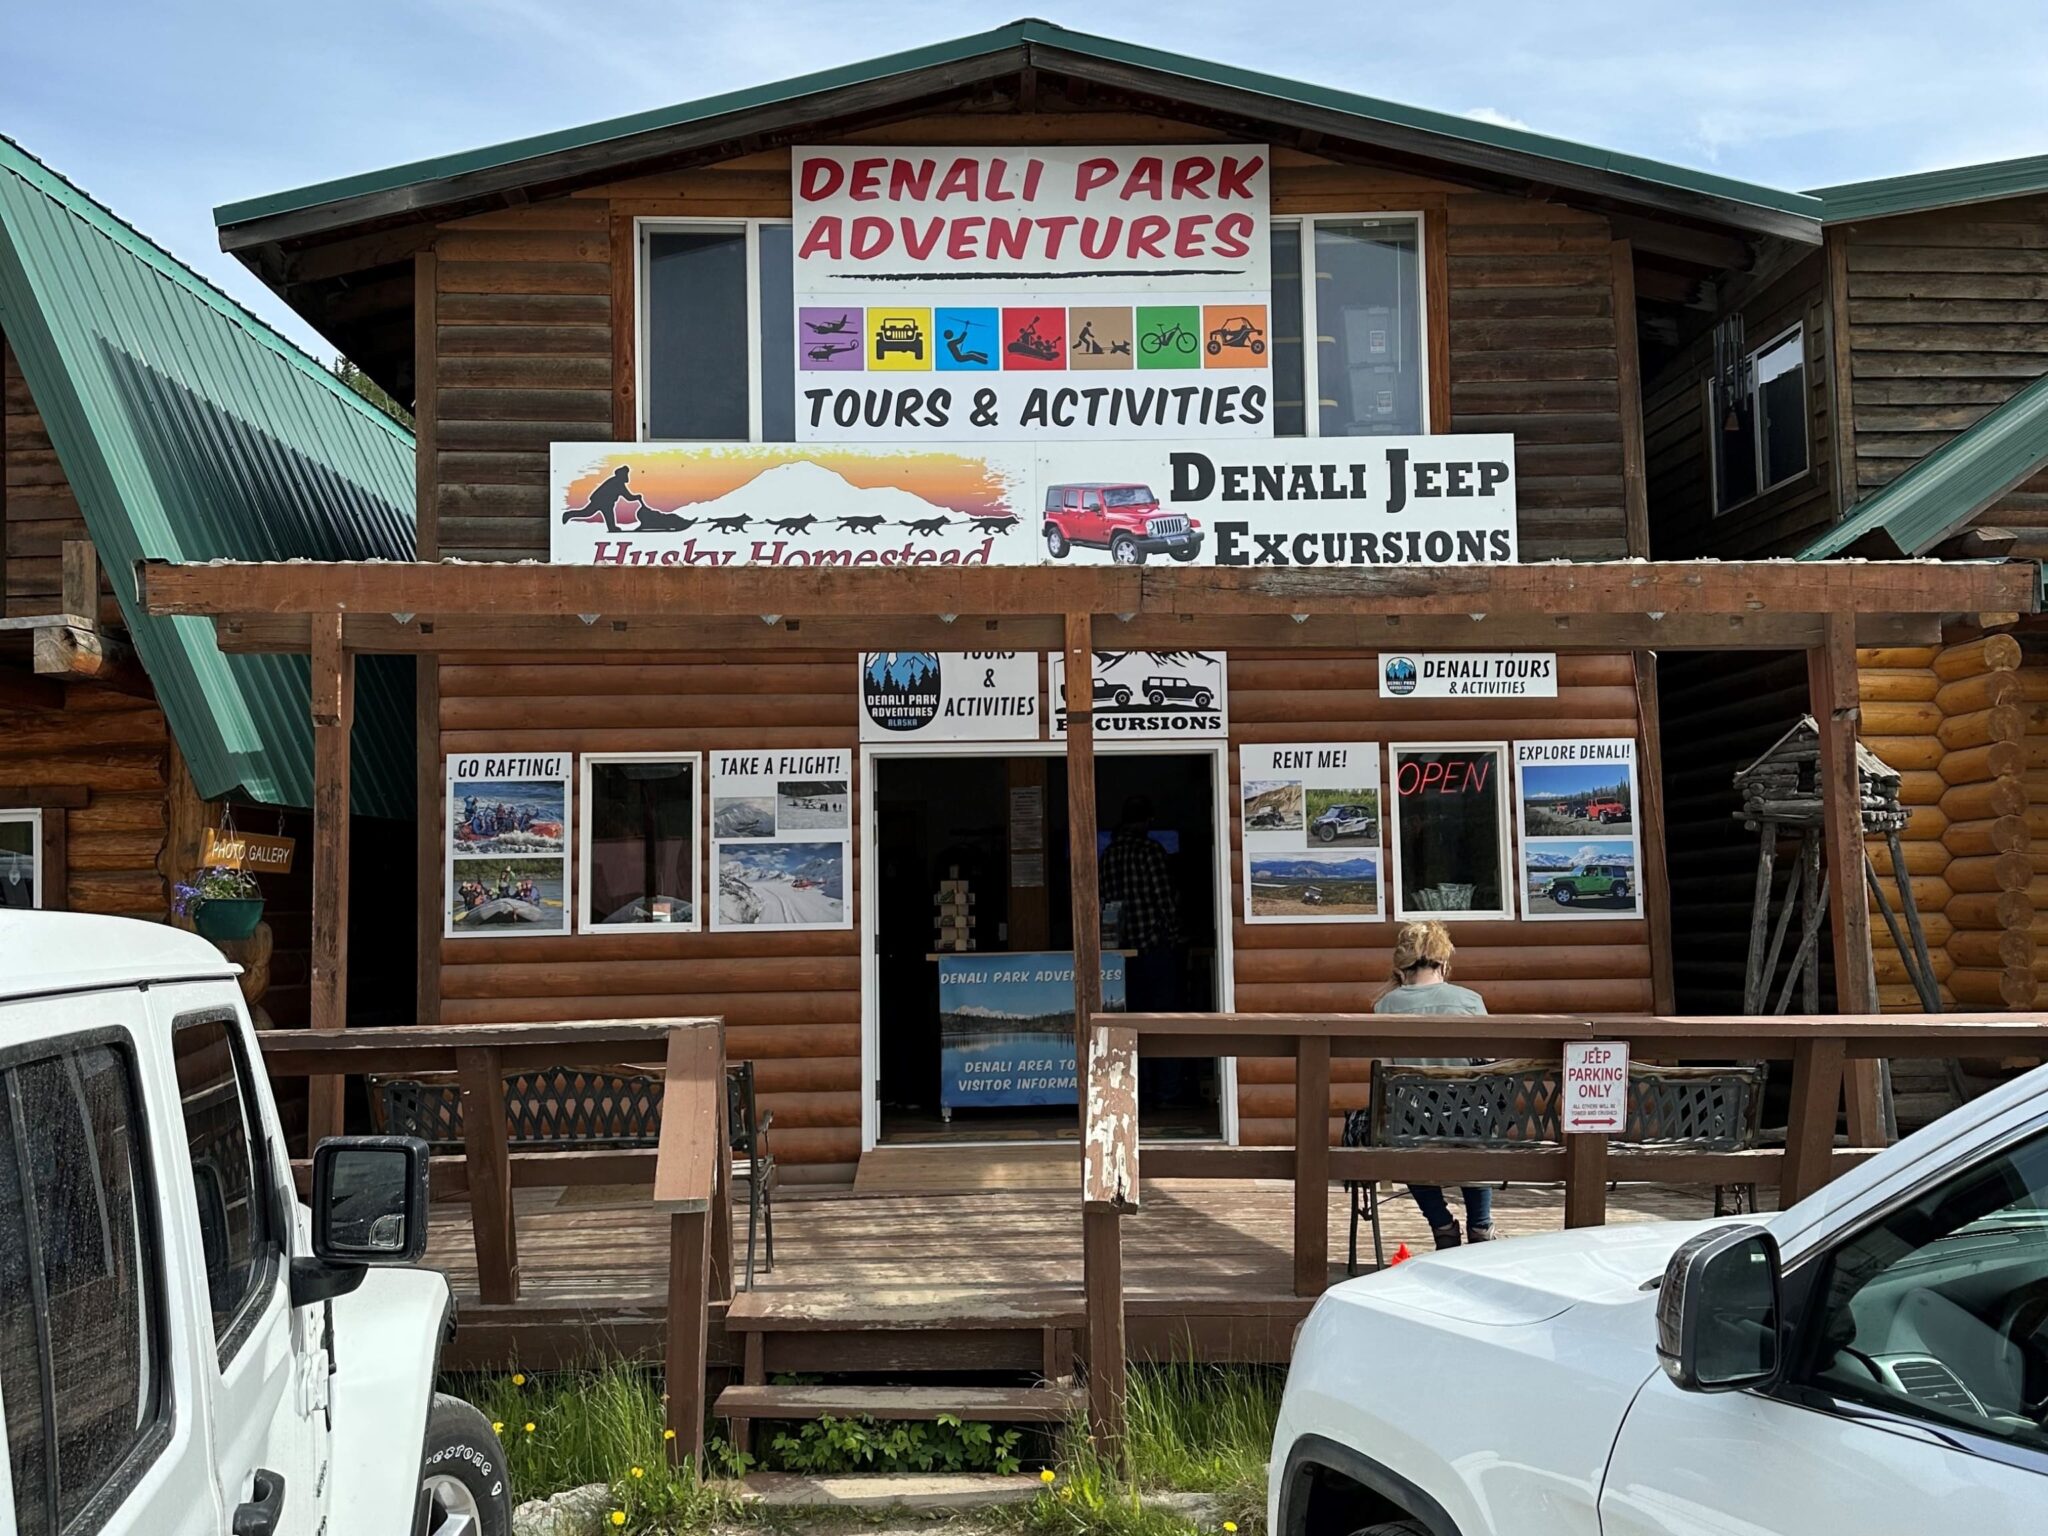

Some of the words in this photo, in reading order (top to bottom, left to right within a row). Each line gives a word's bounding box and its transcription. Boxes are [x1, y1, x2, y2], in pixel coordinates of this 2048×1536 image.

[800, 157, 1045, 202] DENALI
[1074, 155, 1264, 201] PARK
[798, 213, 1255, 261] ADVENTURES
[804, 387, 951, 428] TOURS
[969, 387, 999, 427] &
[1019, 384, 1267, 427] ACTIVITIES
[1423, 660, 1489, 679] DENALI
[1495, 659, 1550, 678] TOURS
[983, 668, 996, 688] &
[1448, 682, 1458, 694] &
[1461, 681, 1526, 694] ACTIVITIES
[867, 694, 905, 706] DENALI
[908, 694, 937, 705] PARK
[944, 696, 1035, 717] ACTIVITIES
[872, 706, 933, 718] ADVENTURES
[887, 718, 918, 727] ALASKA
[1056, 716, 1221, 732] ECURSIONS
[1272, 751, 1313, 769] RENT
[1318, 750, 1347, 768] ME!
[1519, 745, 1576, 760] EXPLORE
[1580, 744, 1630, 759] DENALI!
[458, 759, 479, 777] GO
[485, 758, 561, 777] RAFTING!
[721, 757, 759, 775] TAKE
[764, 757, 773, 775] A
[780, 755, 840, 774] FLIGHT!
[1397, 761, 1489, 795] OPEN
[212, 842, 245, 860] PHOTO
[249, 845, 289, 864] GALLERY
[940, 972, 987, 984] DENALI
[993, 971, 1030, 983] PARK
[1582, 1051, 1611, 1064] JEEP
[965, 1062, 1012, 1073] DENALI
[1018, 1060, 1053, 1072] AREA
[1568, 1067, 1623, 1081] PARKING
[958, 1079, 1012, 1091] VISITOR
[1017, 1077, 1078, 1089] INFORMA
[1579, 1084, 1612, 1098] ONLY
